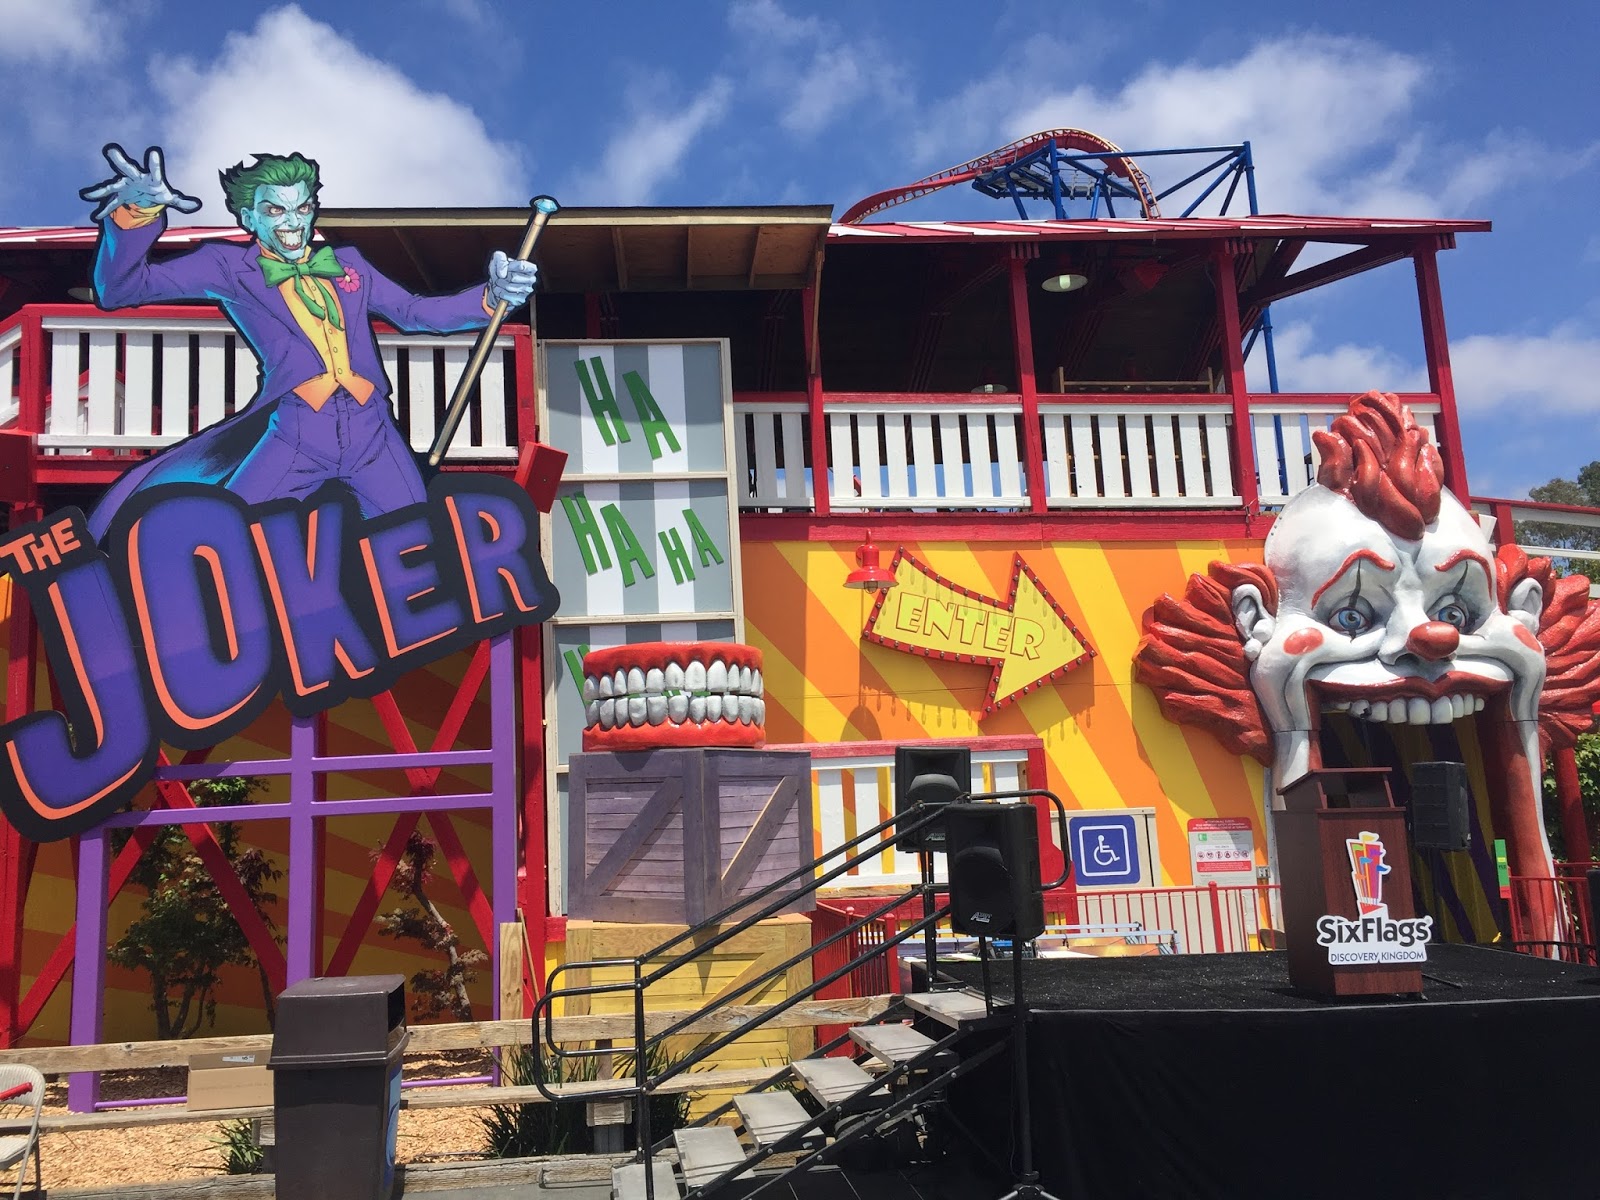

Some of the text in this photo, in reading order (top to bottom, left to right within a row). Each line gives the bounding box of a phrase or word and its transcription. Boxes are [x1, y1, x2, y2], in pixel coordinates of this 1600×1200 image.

[574, 356, 682, 459] HA
[0, 517, 82, 574] THE
[560, 491, 724, 588] HA HA
[7, 495, 538, 820] JOKER
[896, 592, 1045, 660] ENTER
[1331, 951, 1424, 962] DISCOVERY KINGDOM
